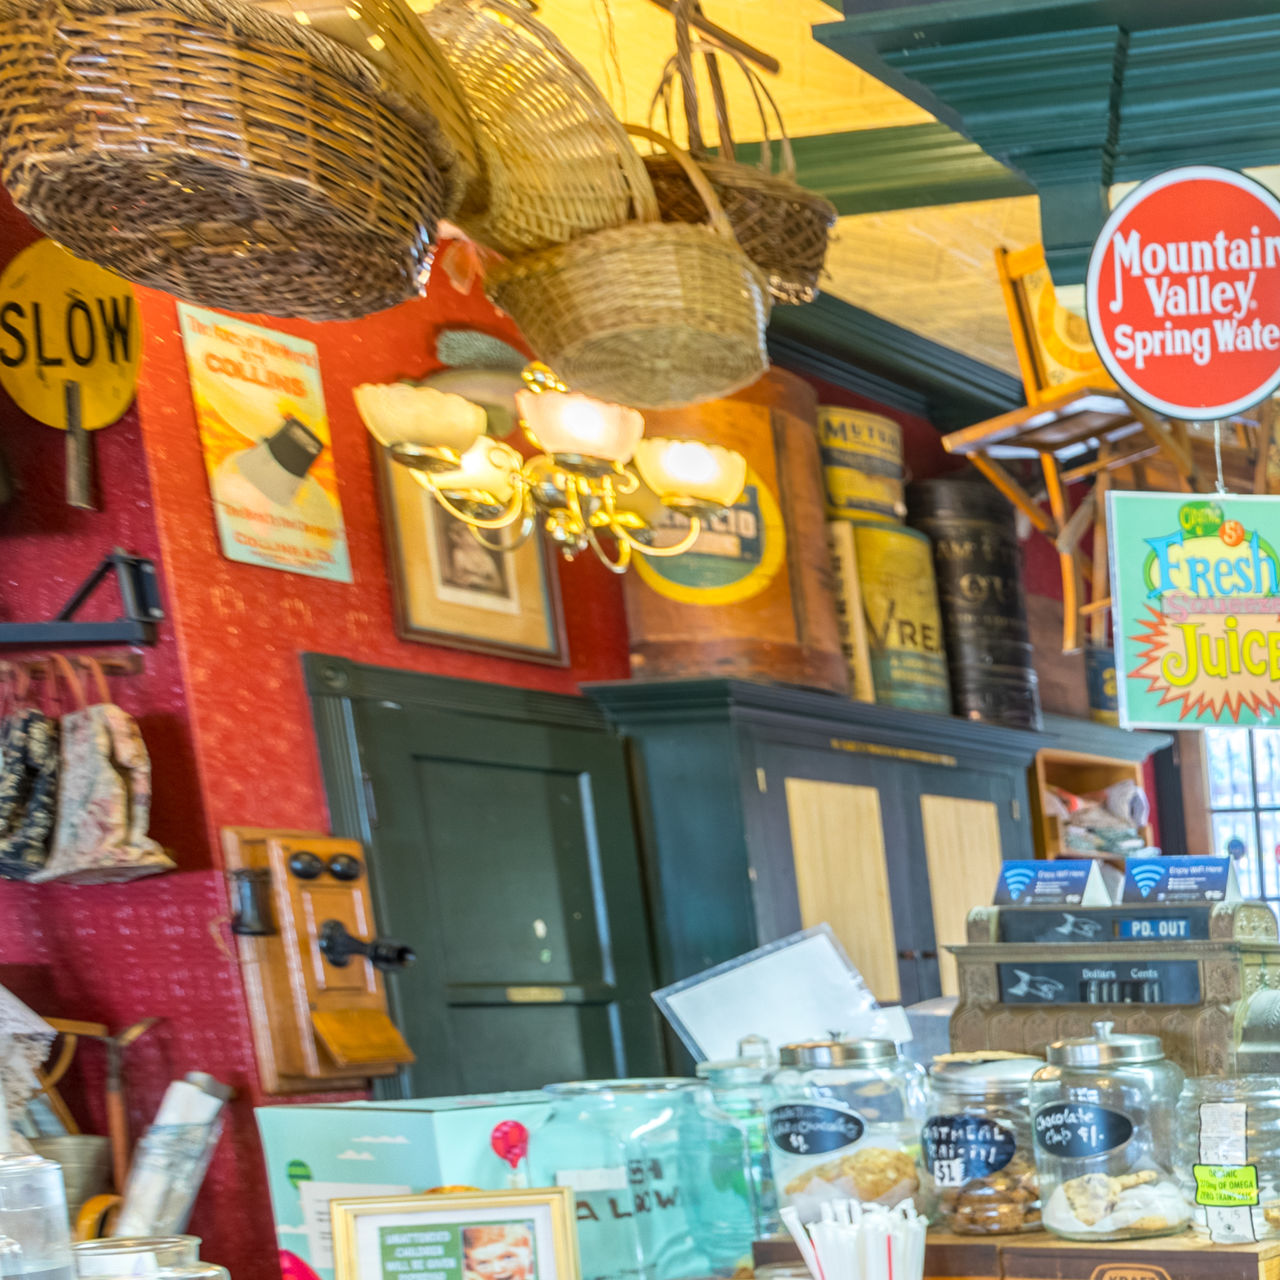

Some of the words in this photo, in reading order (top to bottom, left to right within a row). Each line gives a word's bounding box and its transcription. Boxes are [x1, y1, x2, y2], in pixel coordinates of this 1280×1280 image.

[1144, 272, 1258, 319] Valley
[0, 294, 133, 366] SLOW
[1114, 320, 1211, 369] Spring
[1158, 919, 1186, 937] OUT
